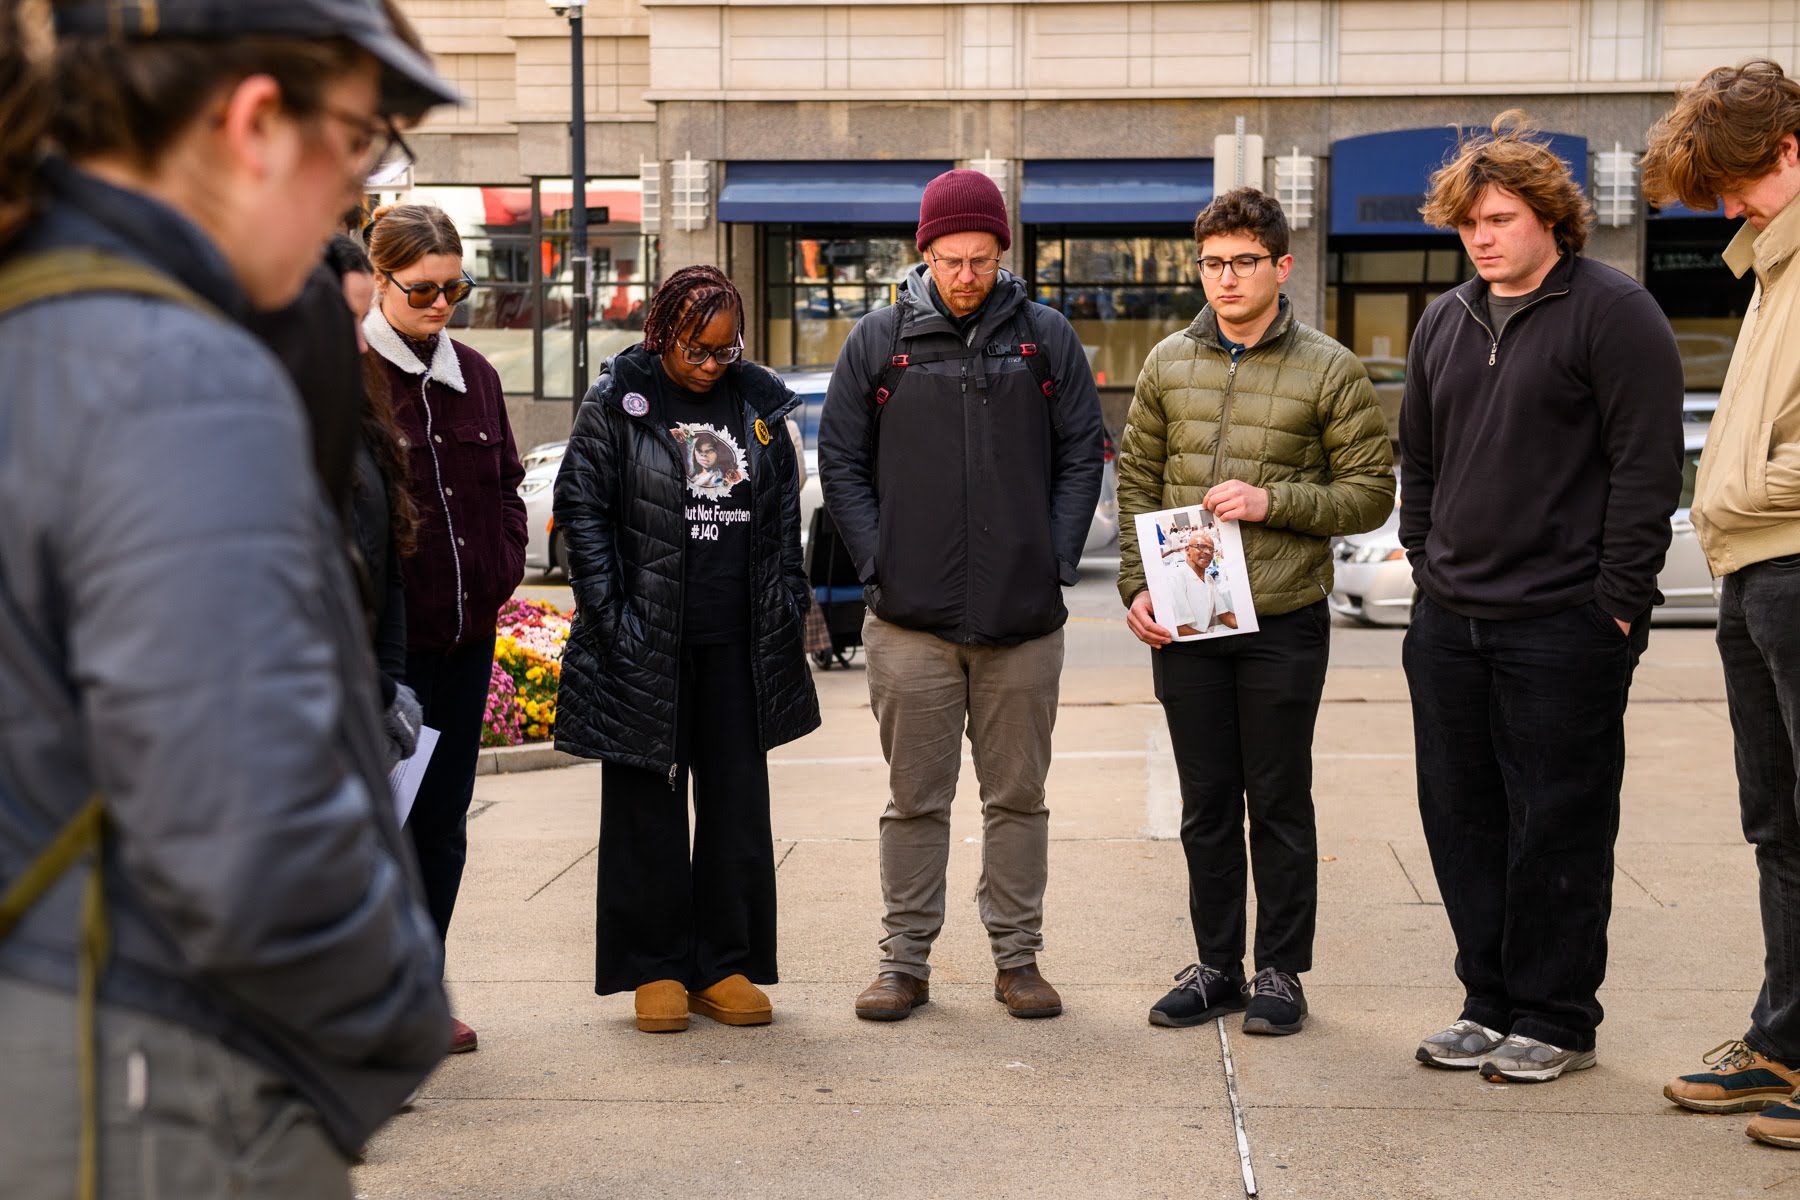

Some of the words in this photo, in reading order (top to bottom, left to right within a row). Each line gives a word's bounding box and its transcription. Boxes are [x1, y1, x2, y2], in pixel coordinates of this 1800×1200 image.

[697, 504, 713, 521] Not
[714, 505, 751, 526] Forgotten
[690, 523, 719, 540] #J4Q
